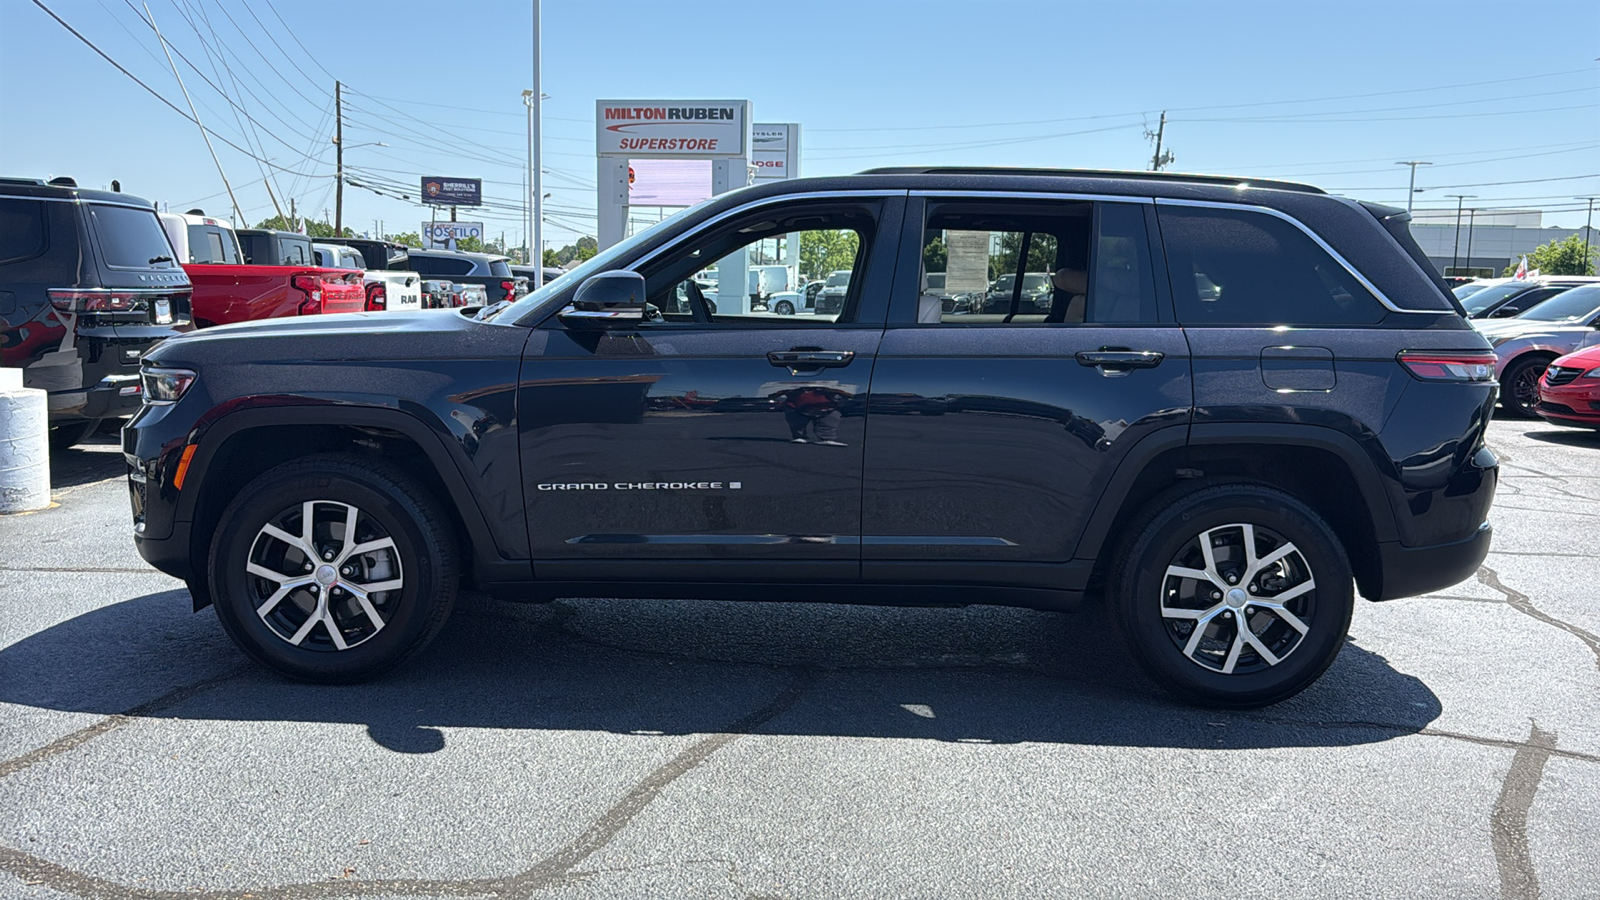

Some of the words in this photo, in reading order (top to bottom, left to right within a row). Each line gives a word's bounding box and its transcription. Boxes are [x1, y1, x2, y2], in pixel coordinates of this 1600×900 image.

[619, 138, 718, 150] SUPERSTORE
[424, 227, 480, 237] HOSTILO
[401, 295, 417, 304] RAM
[537, 482, 608, 491] GRAND
[614, 481, 723, 490] CHEROKEE
